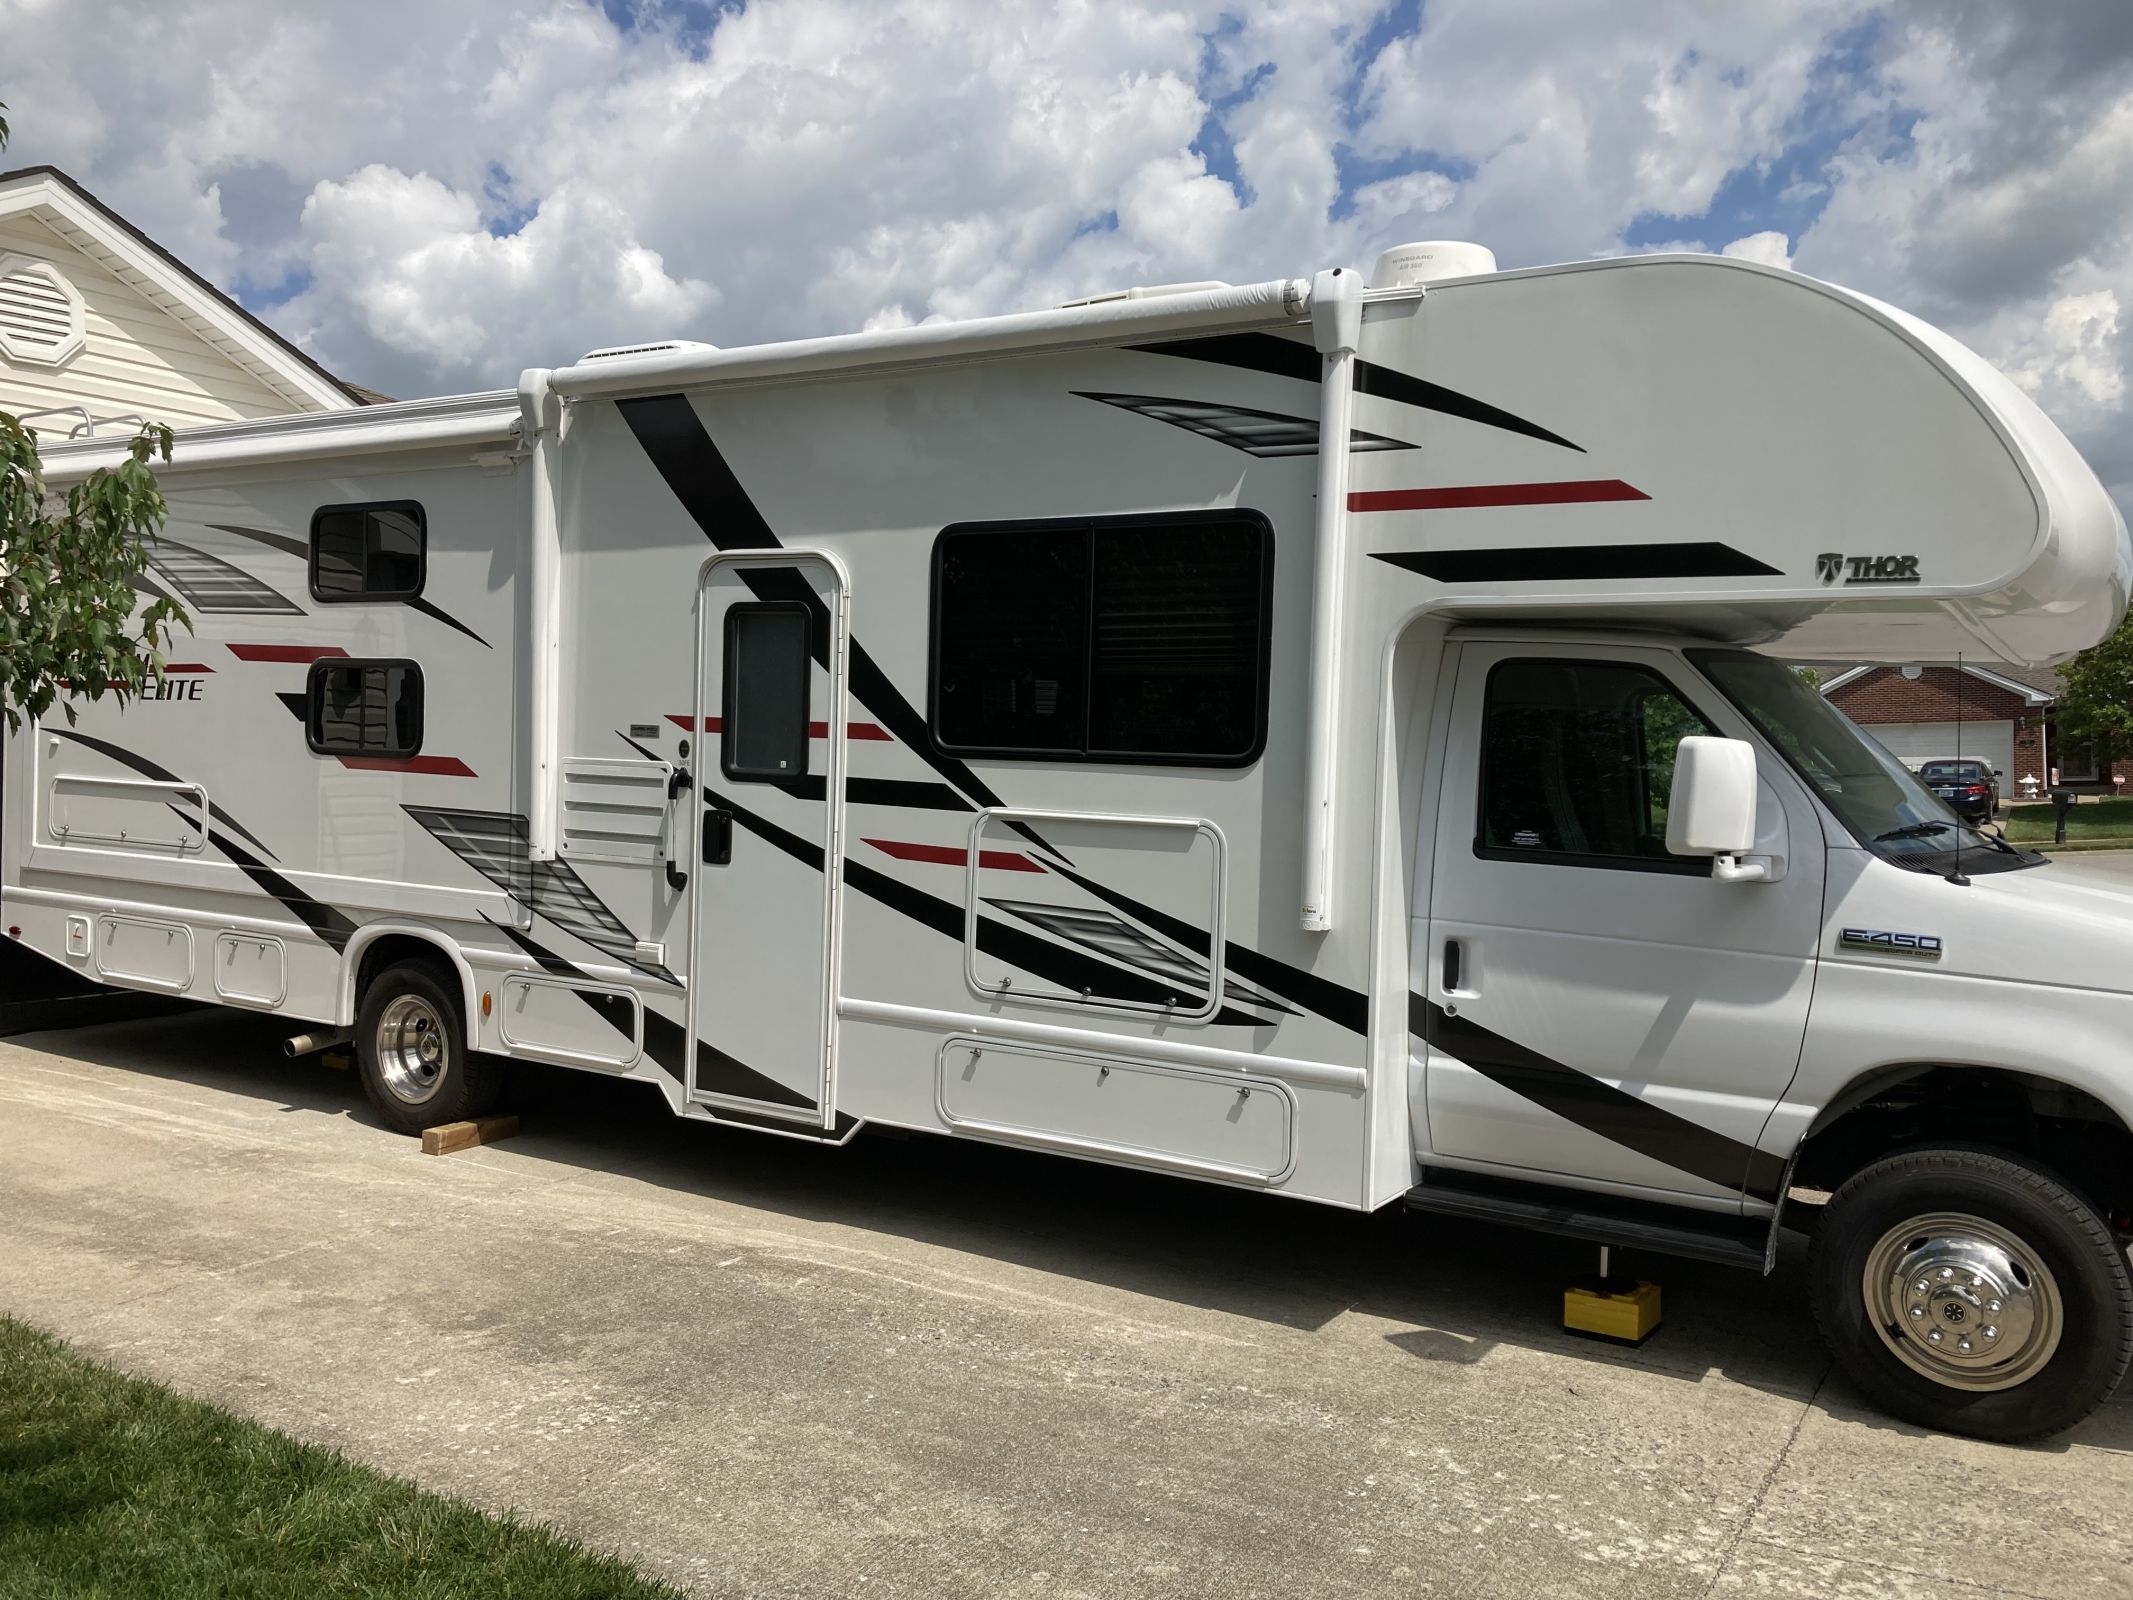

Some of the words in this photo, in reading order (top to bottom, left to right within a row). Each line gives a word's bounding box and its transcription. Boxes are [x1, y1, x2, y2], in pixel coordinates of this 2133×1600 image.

[1846, 555, 1921, 577] THOR
[141, 674, 204, 701] ELITE
[1883, 948, 1912, 956] SUPER
